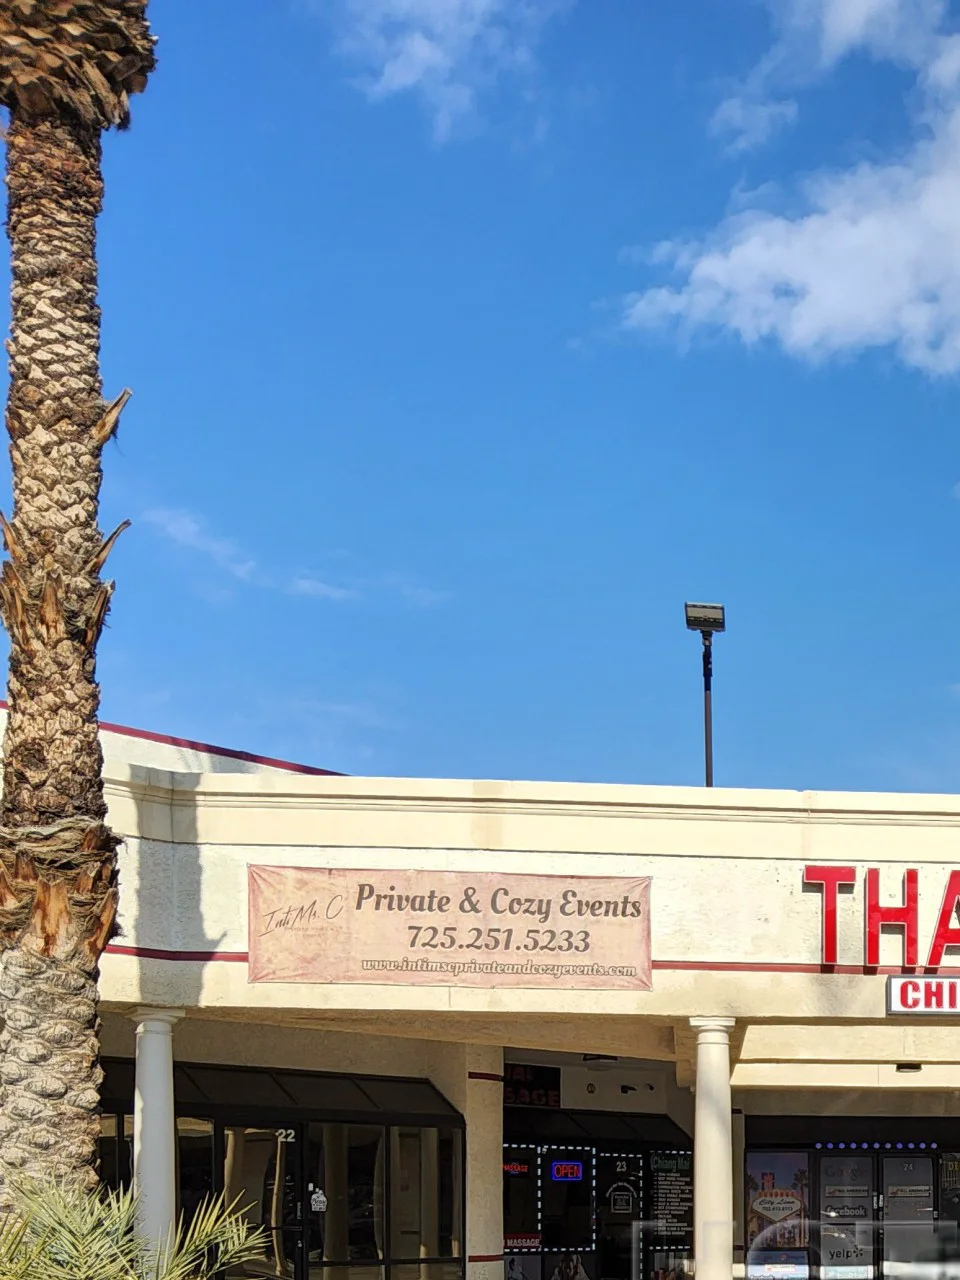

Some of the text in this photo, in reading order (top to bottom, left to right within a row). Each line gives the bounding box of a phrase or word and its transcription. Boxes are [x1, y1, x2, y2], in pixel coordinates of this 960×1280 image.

[355, 883, 642, 923] Private & Cozy Events
[407, 925, 591, 952] 725.251.5233
[278, 1129, 296, 1143] 22
[616, 1161, 627, 1172] 23
[653, 1156, 690, 1172] Chiang Mai
[903, 1163, 913, 1171] 24
[555, 1165, 580, 1177] OPEN
[507, 1238, 540, 1247] MASSAGE
[829, 1248, 853, 1259] yelp
